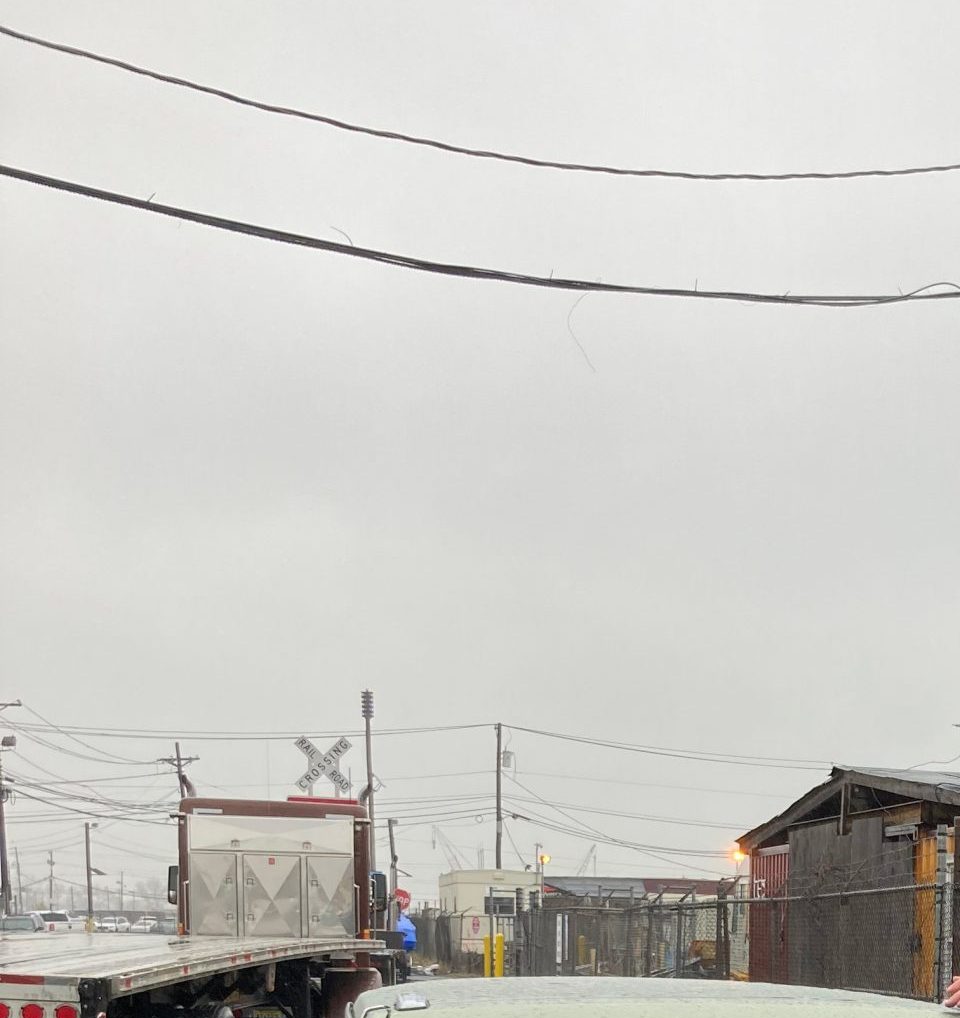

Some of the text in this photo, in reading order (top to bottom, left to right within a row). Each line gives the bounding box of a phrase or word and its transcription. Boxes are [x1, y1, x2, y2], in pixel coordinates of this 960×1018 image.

[298, 739, 316, 759] RAIL
[298, 740, 348, 789] CROSSING
[329, 770, 349, 790] ROAD
